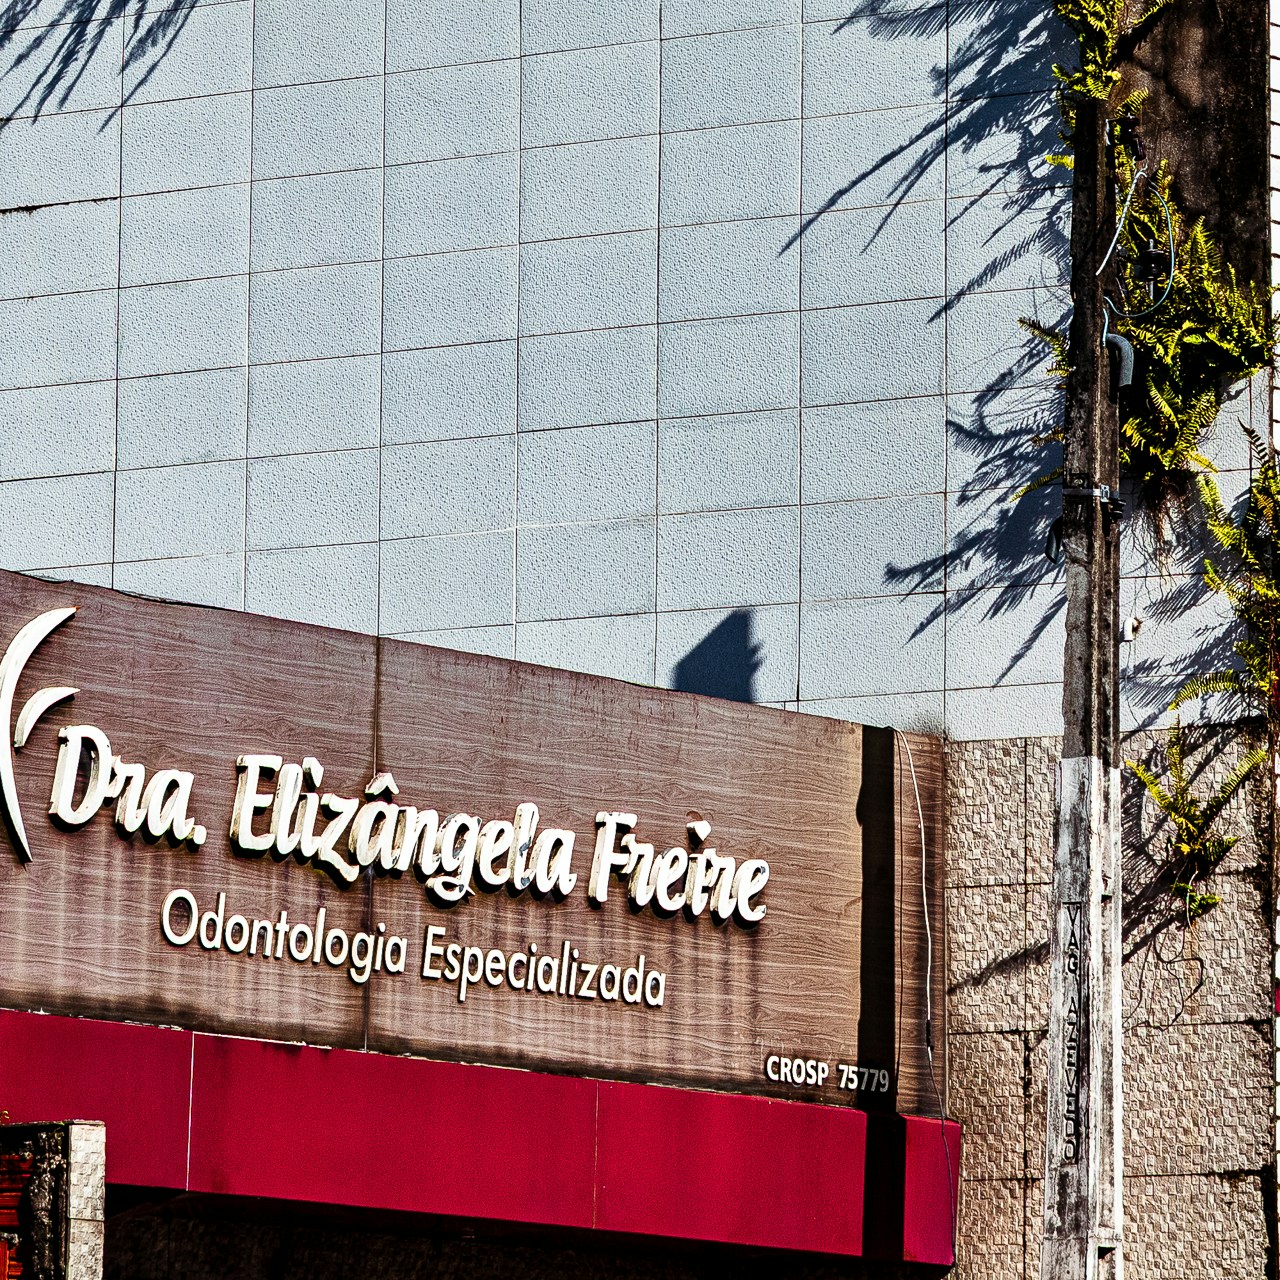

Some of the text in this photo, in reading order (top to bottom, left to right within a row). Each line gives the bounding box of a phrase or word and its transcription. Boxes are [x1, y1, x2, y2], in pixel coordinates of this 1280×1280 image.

[49, 724, 771, 922] Dra. Elizângela Freire
[161, 888, 667, 1007] Odontologia Especializada
[766, 1055, 890, 1093] CROSP 75779
